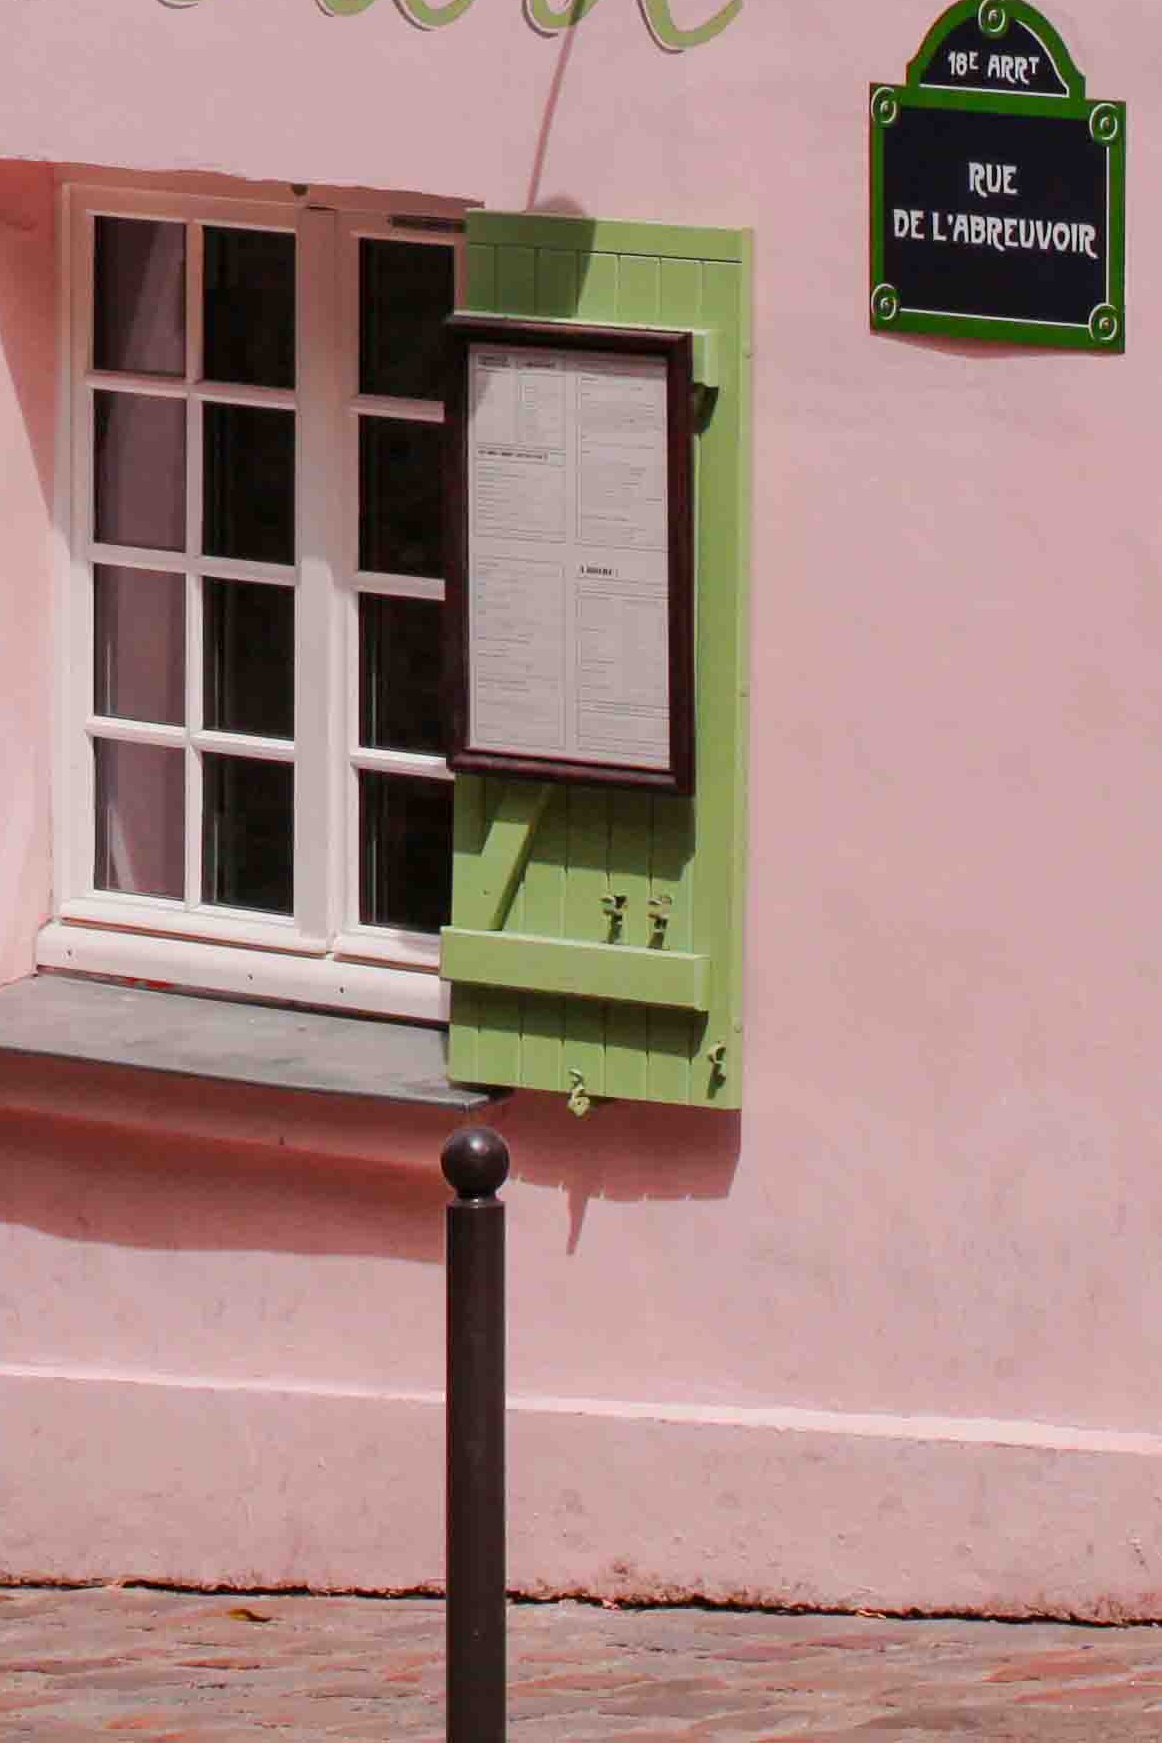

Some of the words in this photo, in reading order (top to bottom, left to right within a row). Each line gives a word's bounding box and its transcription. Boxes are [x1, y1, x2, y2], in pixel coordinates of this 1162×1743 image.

[968, 161, 1019, 198] RUE
[893, 208, 925, 239] DE
[931, 211, 1099, 260] L'ABREUVOIR
